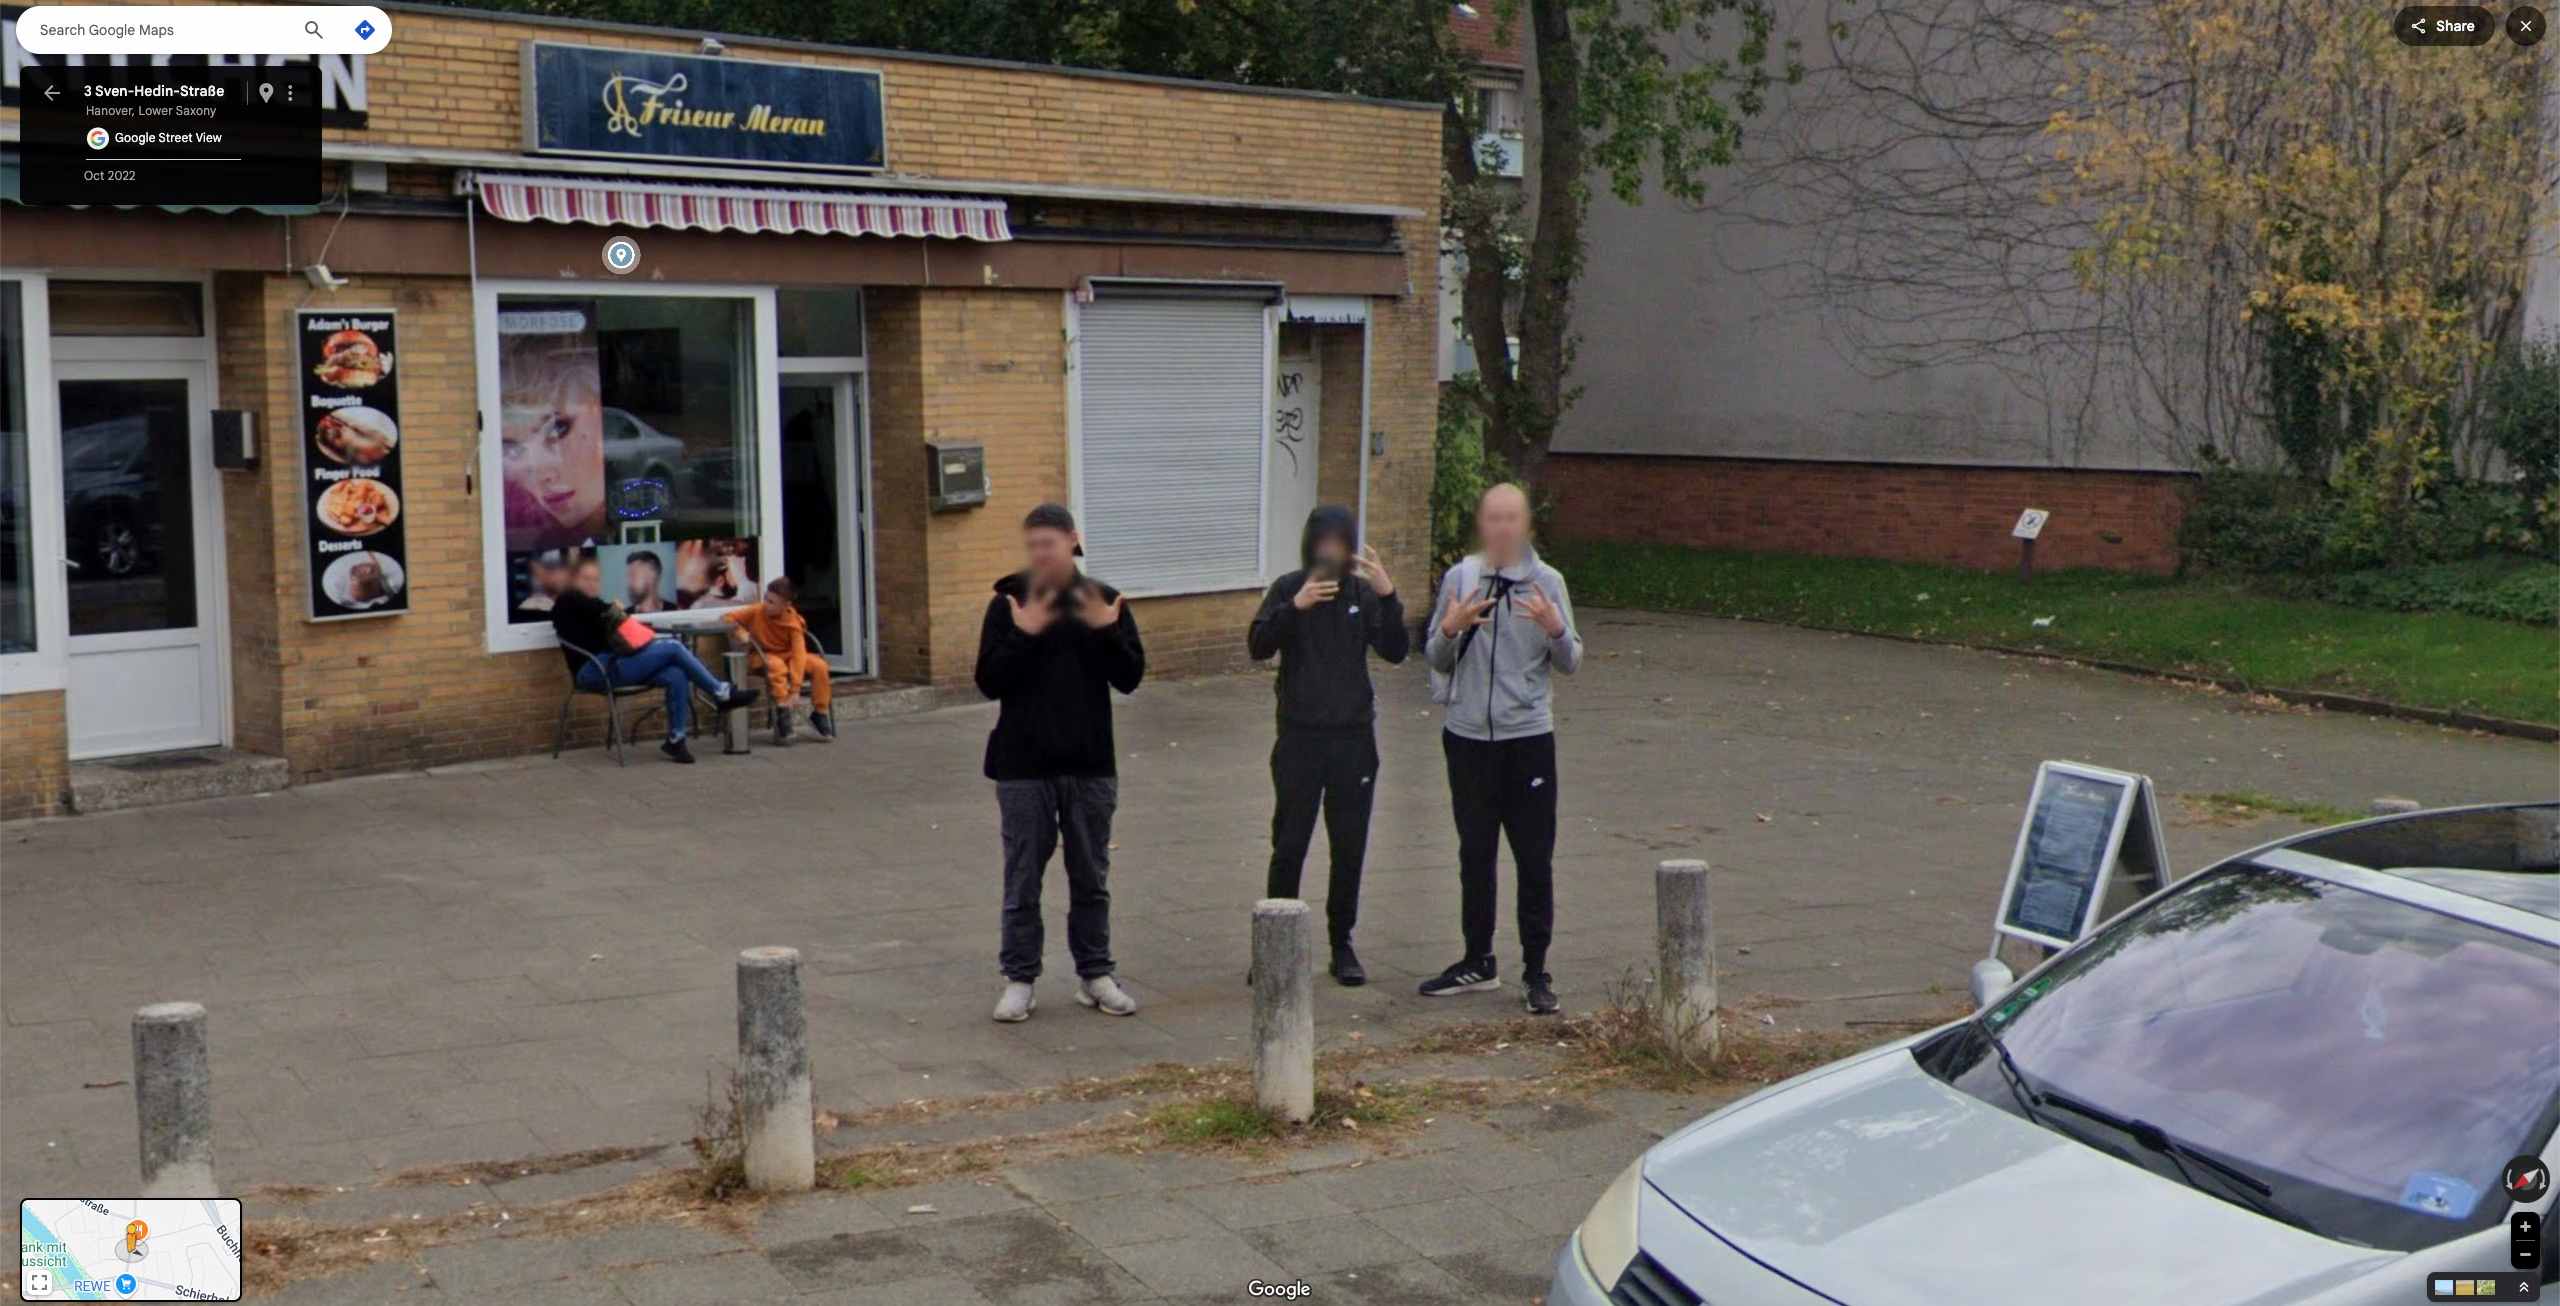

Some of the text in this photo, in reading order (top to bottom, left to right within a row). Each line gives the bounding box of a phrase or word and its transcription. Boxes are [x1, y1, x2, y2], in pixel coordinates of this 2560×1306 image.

[628, 73, 825, 136] Friseur Meran
[307, 318, 390, 332] Adam's Burger
[310, 395, 363, 409] Baguette
[314, 466, 381, 481] Finger Food
[318, 539, 363, 553] Desserts
